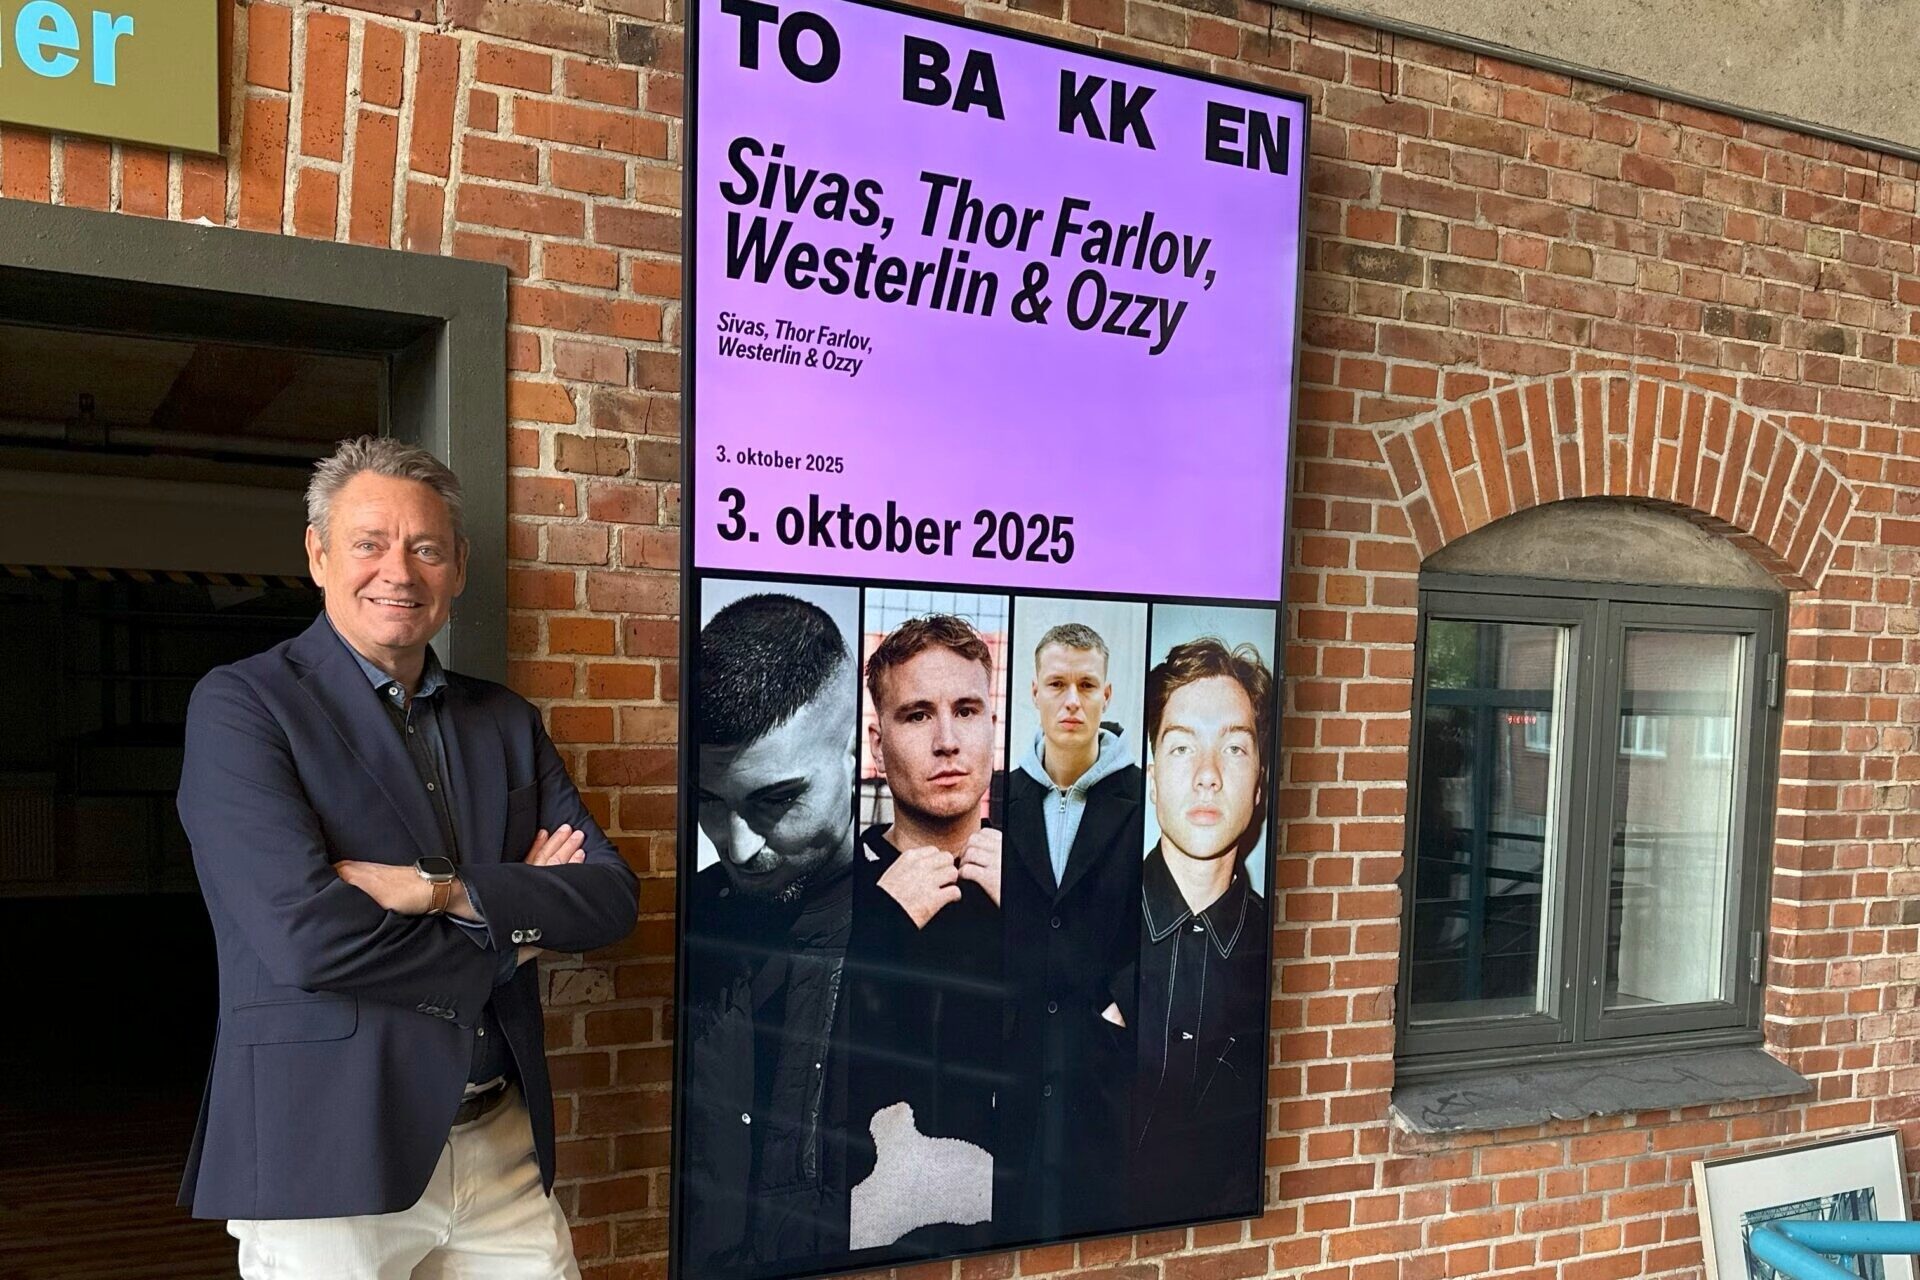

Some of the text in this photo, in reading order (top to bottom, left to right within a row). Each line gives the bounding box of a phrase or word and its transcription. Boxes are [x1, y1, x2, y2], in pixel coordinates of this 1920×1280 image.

[0, 0, 134, 86] er
[720, 0, 1291, 176] TO BA KK EN
[719, 136, 1217, 291] Sivas, Thor Farlov,
[726, 210, 1189, 356] Westerlin & Ozzy
[716, 311, 873, 354] Sivas, Thor Farlov,
[718, 335, 863, 378] Westerlin & Ozzy
[716, 445, 844, 474] 3. oktober 2025
[716, 487, 1075, 564] 3. oktober 2025
